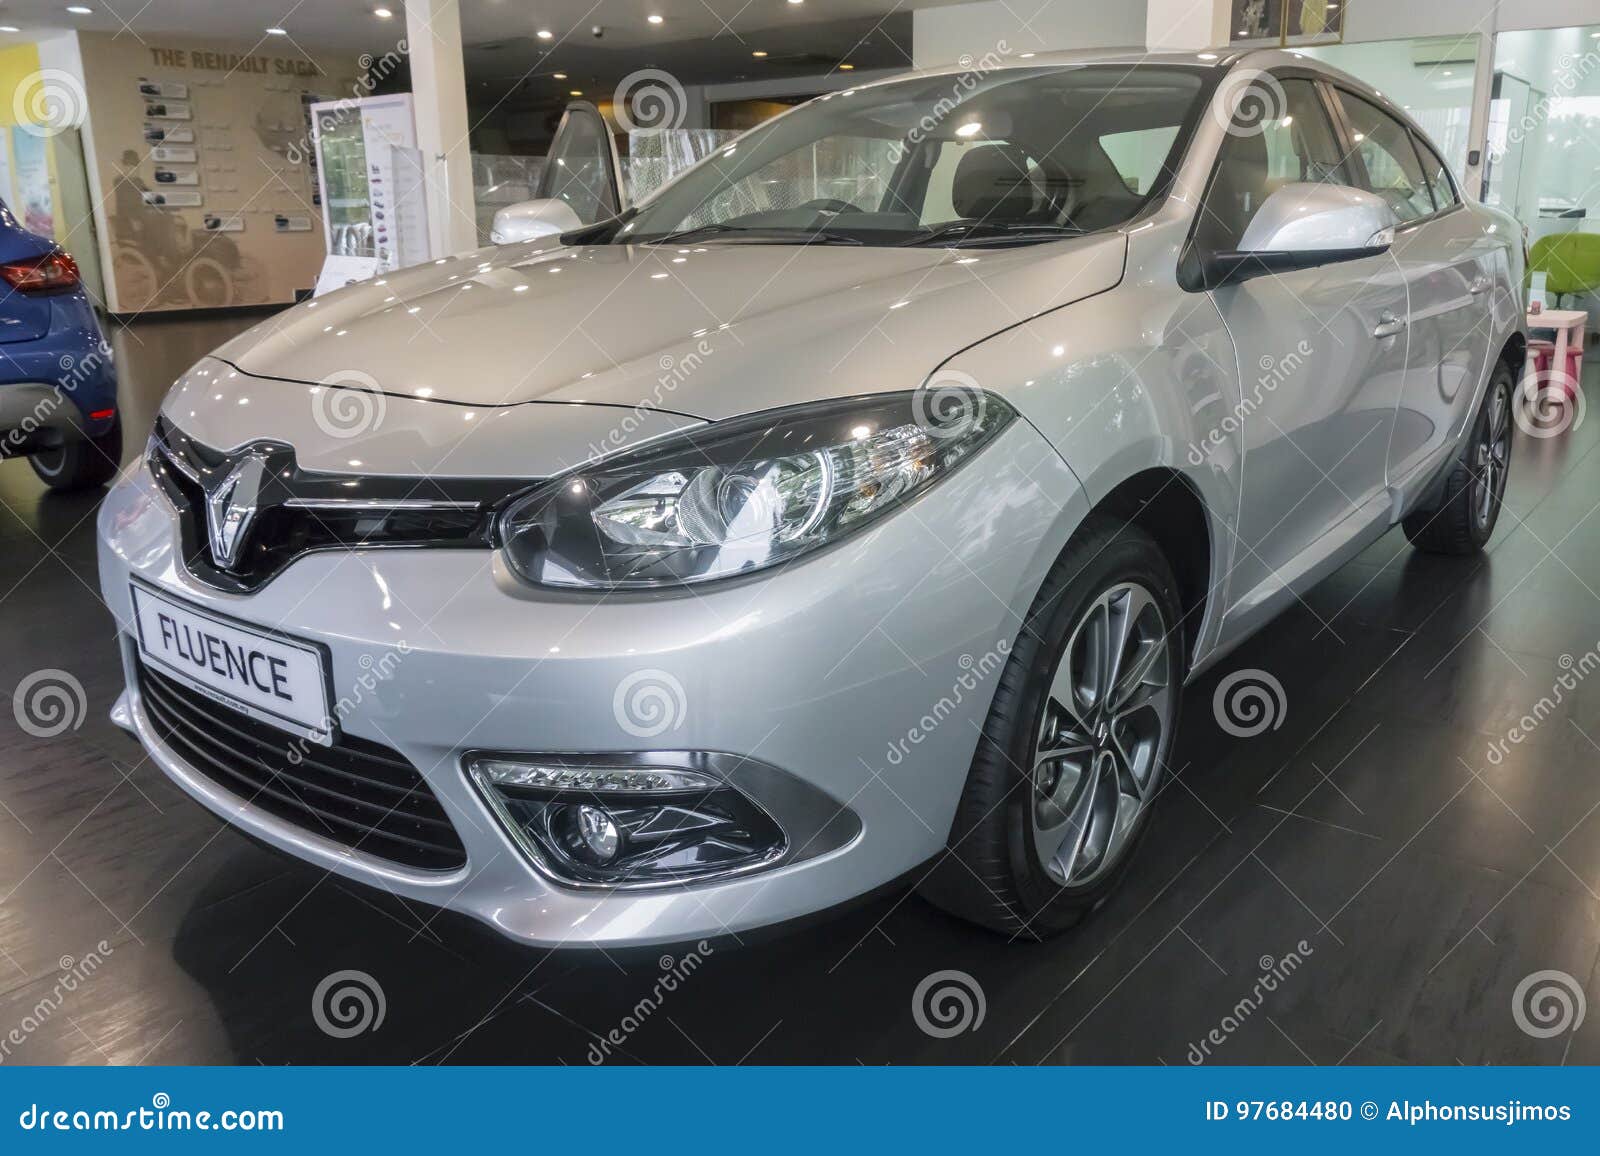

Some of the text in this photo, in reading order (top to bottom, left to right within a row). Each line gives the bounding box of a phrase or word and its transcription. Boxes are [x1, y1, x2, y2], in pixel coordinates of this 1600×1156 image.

[149, 48, 319, 77] THE RENAULT SAGA
[158, 613, 293, 701] FLUENCE
